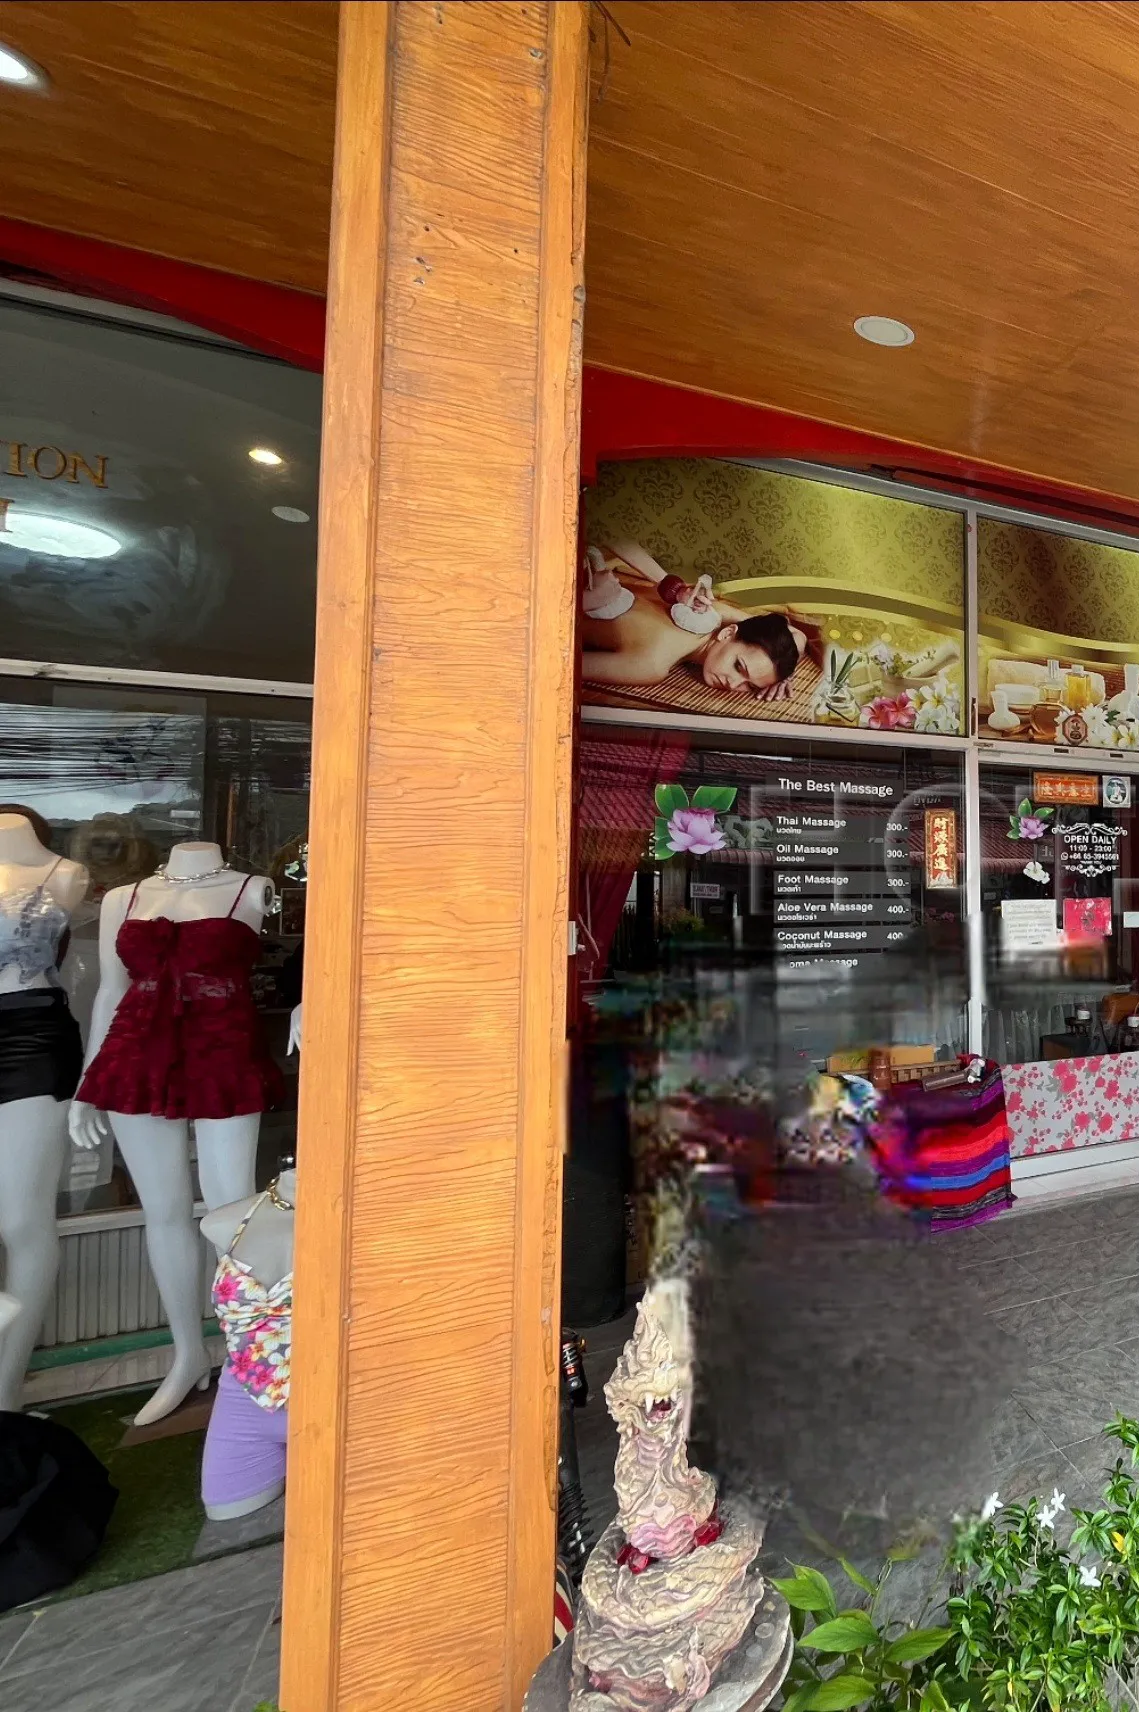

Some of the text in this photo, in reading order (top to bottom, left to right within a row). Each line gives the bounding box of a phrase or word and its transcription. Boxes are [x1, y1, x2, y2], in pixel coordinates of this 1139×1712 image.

[778, 777, 894, 797] The Best Massage
[776, 816, 909, 832] Thai Massage 300.-
[1063, 835, 1117, 845] OPEN DAILY
[776, 844, 909, 858] Oil Massage 300.-
[777, 874, 909, 887] Foot Massage 300.-
[777, 902, 909, 914] Aloe Vera Massage 400.-
[777, 931, 821, 940] Coconut
[824, 930, 868, 941] Massage
